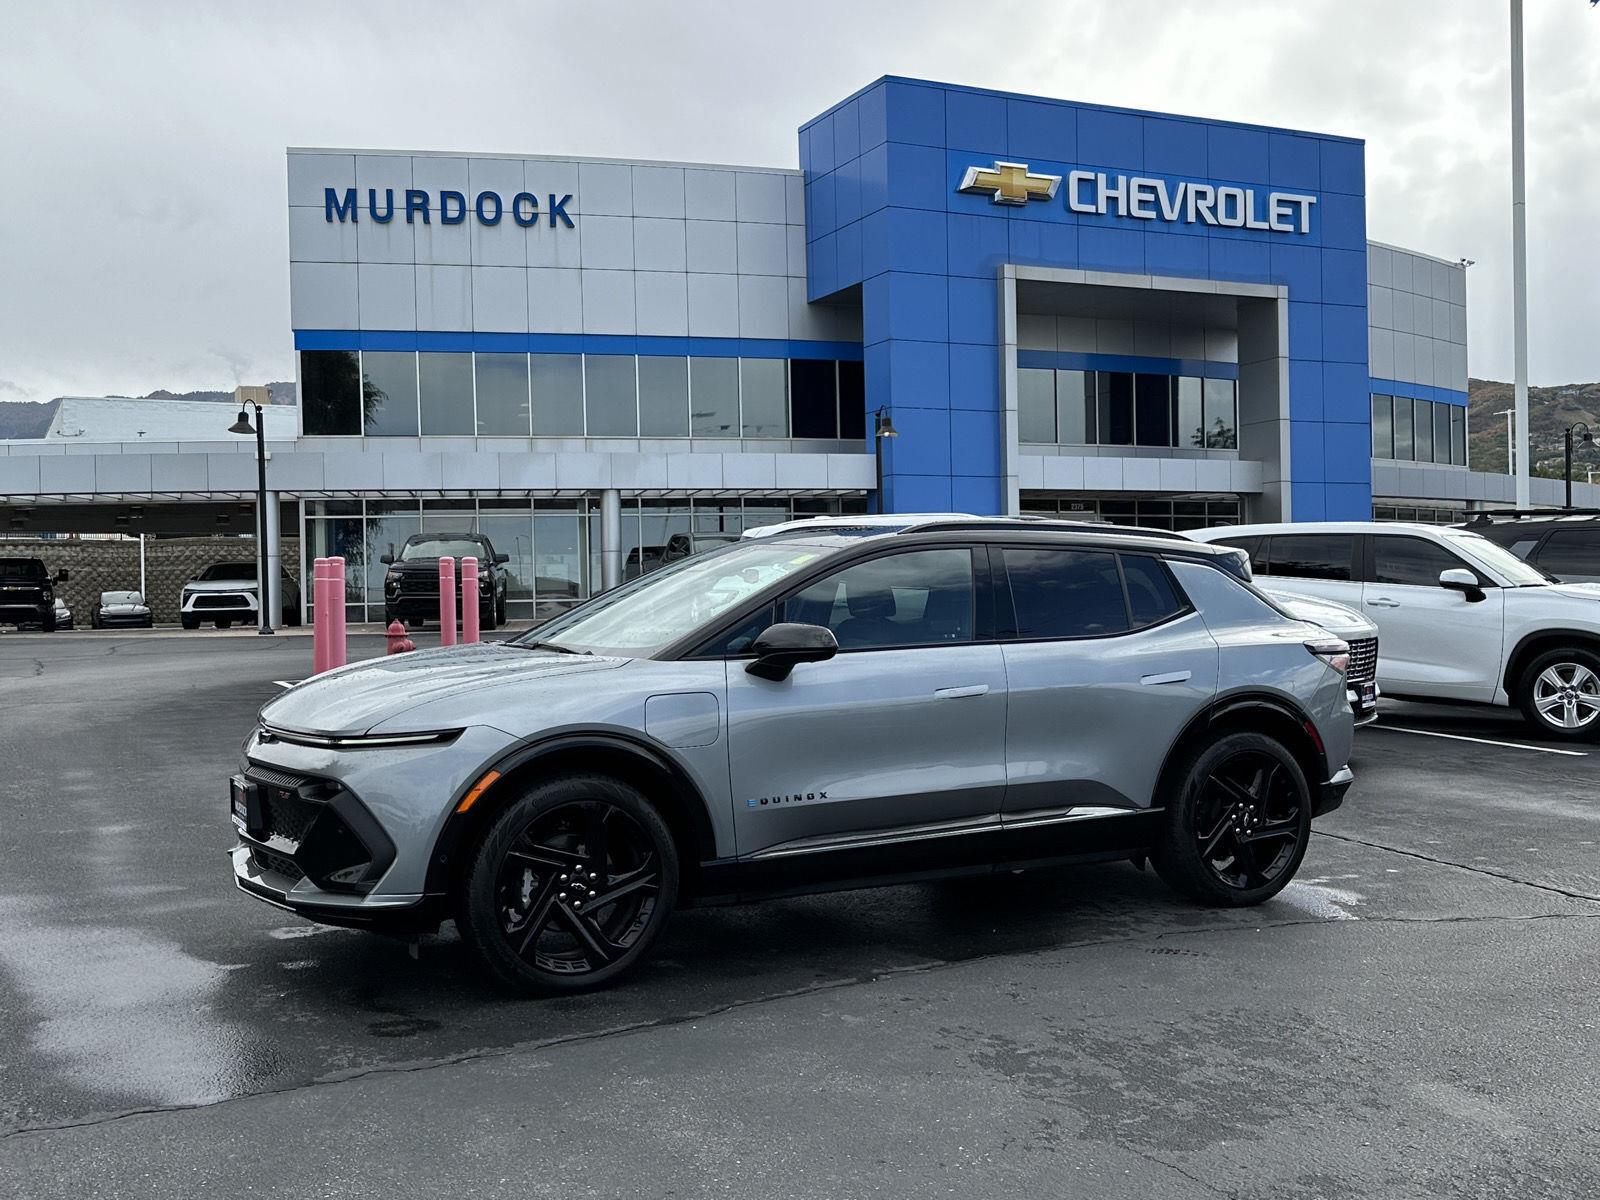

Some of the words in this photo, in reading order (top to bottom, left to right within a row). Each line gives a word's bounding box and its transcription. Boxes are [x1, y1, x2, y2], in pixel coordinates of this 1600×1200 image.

[324, 187, 575, 229] MURDOCK
[1067, 170, 1317, 234] CHEVROLET
[746, 791, 828, 808] EQUINOX
